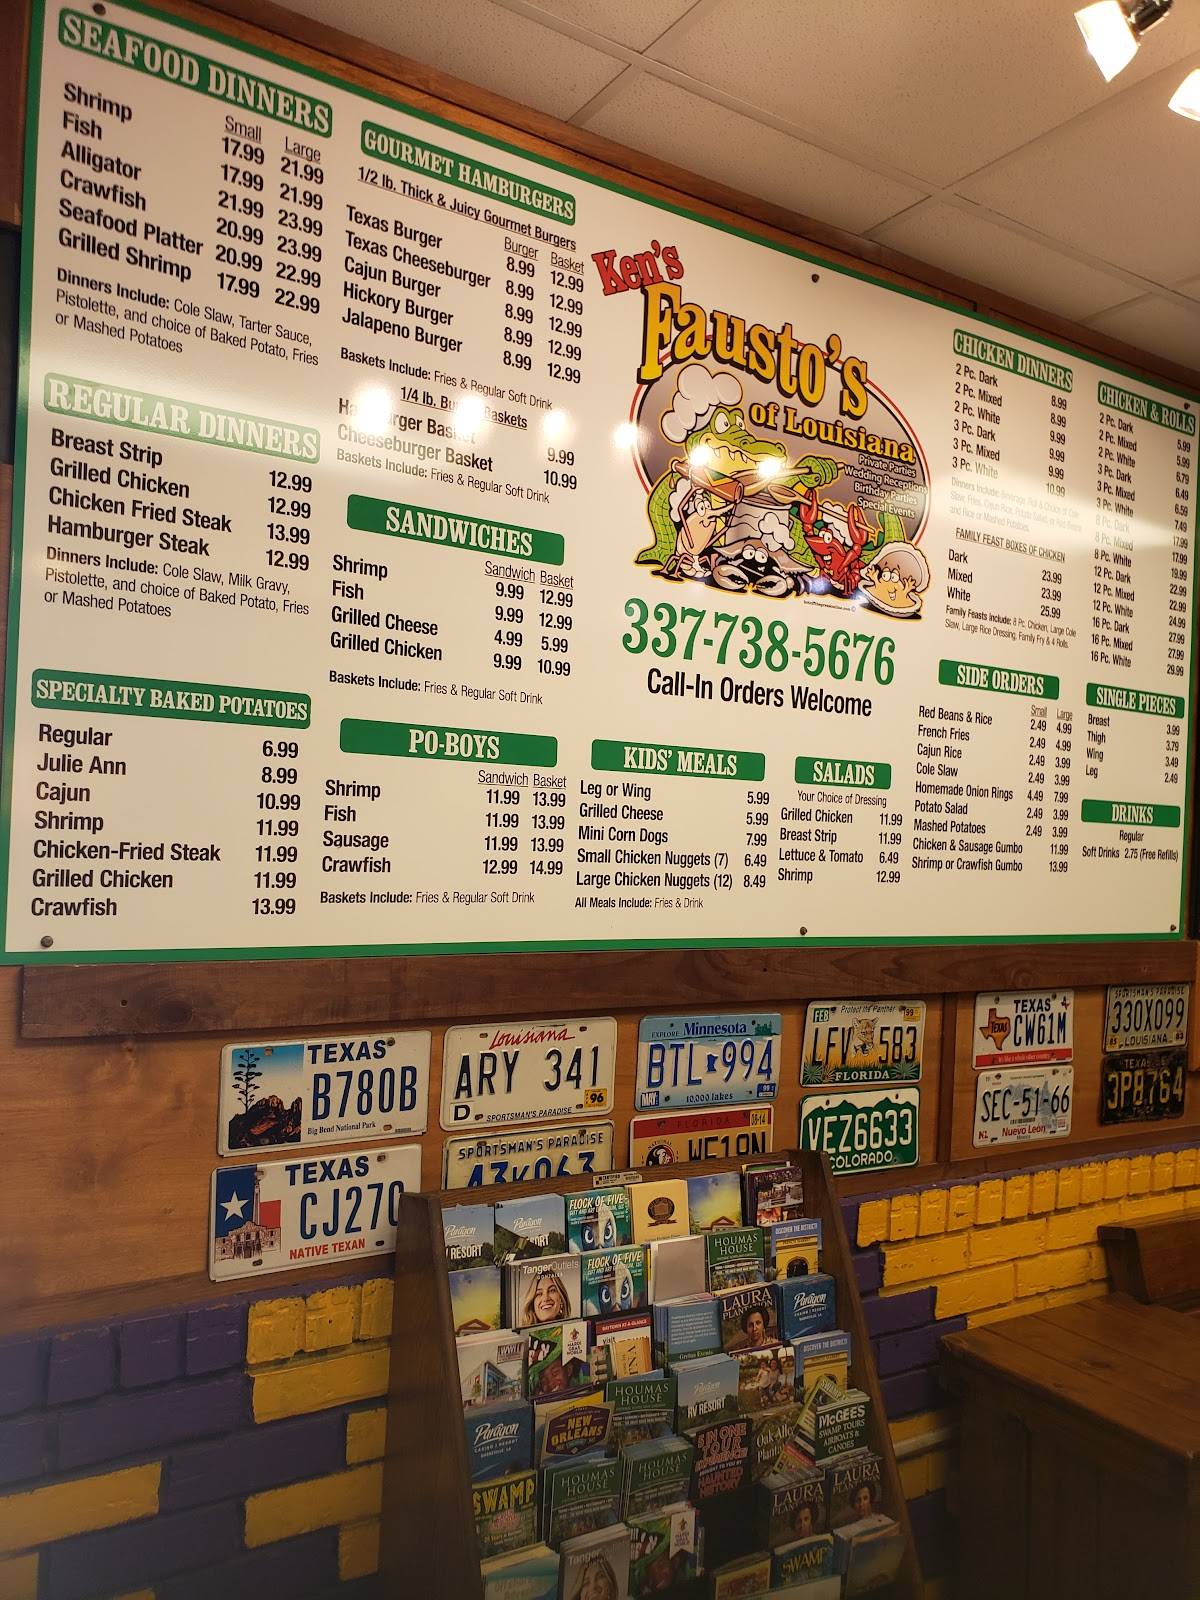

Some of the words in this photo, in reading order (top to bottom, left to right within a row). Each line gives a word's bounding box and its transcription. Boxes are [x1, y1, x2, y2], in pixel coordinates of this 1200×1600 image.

[62, 14, 200, 87] SEAFOOD
[207, 63, 330, 134] DINNERS
[63, 82, 132, 123] Shrimp
[221, 137, 265, 165] 17.99
[280, 157, 324, 185] 21.99
[224, 115, 262, 142] Small
[284, 136, 321, 162] Large
[364, 127, 454, 177] GOURMET
[458, 162, 574, 220] HAMBURGERS
[61, 140, 141, 181] Alligator
[218, 190, 264, 219] 21.99
[277, 209, 323, 237] 23.99
[358, 166, 378, 184] 1/2
[382, 171, 396, 190] lb.
[401, 180, 433, 203] Thick
[437, 193, 446, 206] &
[450, 198, 480, 220] Juicy
[484, 209, 532, 235] Gourmet
[535, 226, 577, 250] Burgers
[347, 204, 388, 233] Texas
[394, 220, 442, 249] Burger
[507, 257, 535, 278] 8.99
[550, 271, 584, 293] 12.99
[591, 240, 685, 296] Ken's
[637, 281, 868, 418] Fausto's
[954, 333, 1014, 367] CHICKEN
[1017, 352, 1073, 391] DINNERS
[956, 364, 961, 376] 2
[964, 366, 977, 382] Pc.
[979, 370, 998, 388] Dark
[1051, 396, 1067, 410] 8.99
[49, 379, 190, 435] REGULAR
[198, 411, 318, 460] DINNERS
[1099, 386, 1148, 417] CHICKEN
[1150, 401, 1159, 420] &
[1161, 404, 1195, 434] ROLLS
[749, 401, 778, 432] of
[784, 409, 916, 464] Louisiana
[845, 465, 882, 484] Wedding
[884, 475, 927, 494] Receptions
[859, 454, 887, 470] Private
[889, 462, 916, 477] Parties
[48, 515, 153, 549] Hamburger
[159, 532, 210, 556] Steak
[266, 550, 310, 571] 12.99
[386, 506, 533, 556] SANDWICHES
[333, 555, 388, 580] Shrimp
[496, 582, 524, 600] 9.99
[539, 589, 573, 608] 12.99
[485, 561, 535, 582] Sandwich
[540, 571, 574, 588] Basket
[622, 598, 896, 685] 337-738-5676
[1091, 651, 1098, 662] 16
[1101, 653, 1111, 665] Pc.
[1113, 654, 1131, 668] White
[1167, 664, 1184, 677] 29.99
[648, 668, 713, 700] Call-In
[720, 677, 784, 707] Orders
[791, 685, 872, 716] Welcome
[957, 665, 989, 687] SIDE
[992, 670, 1044, 696] ORDERS
[36, 679, 146, 706] SPECIALTY
[150, 688, 215, 712] BAKED
[219, 695, 308, 720] POTATOES
[1097, 688, 1136, 709] SINGLE
[1138, 693, 1175, 716] PIECES
[919, 706, 935, 719] Red
[938, 708, 965, 722] Beans
[967, 711, 973, 722] &
[975, 712, 992, 725] Rice
[1031, 720, 1047, 731] 2.49
[1056, 723, 1072, 734] 4.99
[38, 723, 113, 748] Regular
[262, 740, 299, 758] 6.99
[408, 728, 500, 760] PO-BOYS
[623, 747, 673, 769] KIDS'
[677, 752, 737, 776] MEALS
[814, 761, 875, 785] SALADS
[580, 780, 602, 798] Leg
[606, 784, 618, 797] or
[622, 783, 651, 800] Wing
[747, 792, 769, 805] 5.99
[1112, 804, 1153, 824] DRINKS
[33, 840, 164, 861] Chicken-Fried
[170, 843, 221, 862] Steak
[255, 846, 298, 863] 11.99
[779, 848, 816, 862] Lettuce
[819, 849, 826, 862] &
[829, 849, 864, 863] Tomato
[879, 852, 899, 864] 6.49
[322, 856, 391, 873] Crawfish
[483, 860, 518, 875] 12.99
[530, 861, 563, 876] 14.99
[31, 897, 117, 916] Crawfish
[251, 898, 296, 915] 13.99
[814, 1009, 829, 1022] FEB
[1014, 998, 1051, 1014] TEXAS
[1111, 997, 1185, 1033] 330X099
[489, 1025, 576, 1050] Louisiana
[684, 1022, 747, 1036] Minnesota
[1013, 1012, 1067, 1047] CW61M
[1122, 1034, 1168, 1047] LOUISIANA
[308, 1039, 386, 1064] TEXAS
[879, 1025, 917, 1064] 583
[455, 1050, 520, 1100] ARY
[544, 1045, 599, 1091] 341
[647, 1041, 702, 1088] BTL
[722, 1038, 773, 1082] 994
[835, 1070, 890, 1081] FLORIDA
[312, 1066, 417, 1121] B780B
[711, 1092, 733, 1100] lakes
[981, 1084, 1070, 1123] SEC-51-66
[335, 1122, 361, 1132] National
[362, 1121, 376, 1129] Park
[453, 1104, 471, 1121] D
[486, 1110, 537, 1122] SPORTSMAN'S
[539, 1107, 572, 1118] PARADISE
[808, 1109, 912, 1154] VEZ6633
[1002, 1126, 1026, 1137] Nuevo
[1027, 1125, 1046, 1134] León
[458, 1138, 543, 1160] SPORTSMAN'S
[548, 1132, 604, 1149] PARADISE
[830, 1150, 894, 1168] COLORADO
[285, 1156, 369, 1186] TEXAS
[290, 1244, 329, 1260] NATIVE
[332, 1238, 365, 1254] TEXAN
[450, 1244, 483, 1260] RESORT
[715, 1234, 758, 1247] HOUMAS
[720, 1243, 753, 1255] HOUSE
[588, 1256, 611, 1270] FLOCK
[612, 1254, 622, 1266] OF
[623, 1251, 642, 1264] FIVE
[723, 1288, 772, 1312] LAURA
[794, 1293, 826, 1309] Paragon
[688, 1406, 697, 1418] RV
[699, 1398, 725, 1415] RESORT
[551, 1425, 603, 1445] ORLEANS
[567, 1415, 592, 1431] NEW
[819, 1425, 842, 1438] SWAMP
[843, 1419, 865, 1431] TOURS
[473, 1479, 535, 1516] SWAMP
